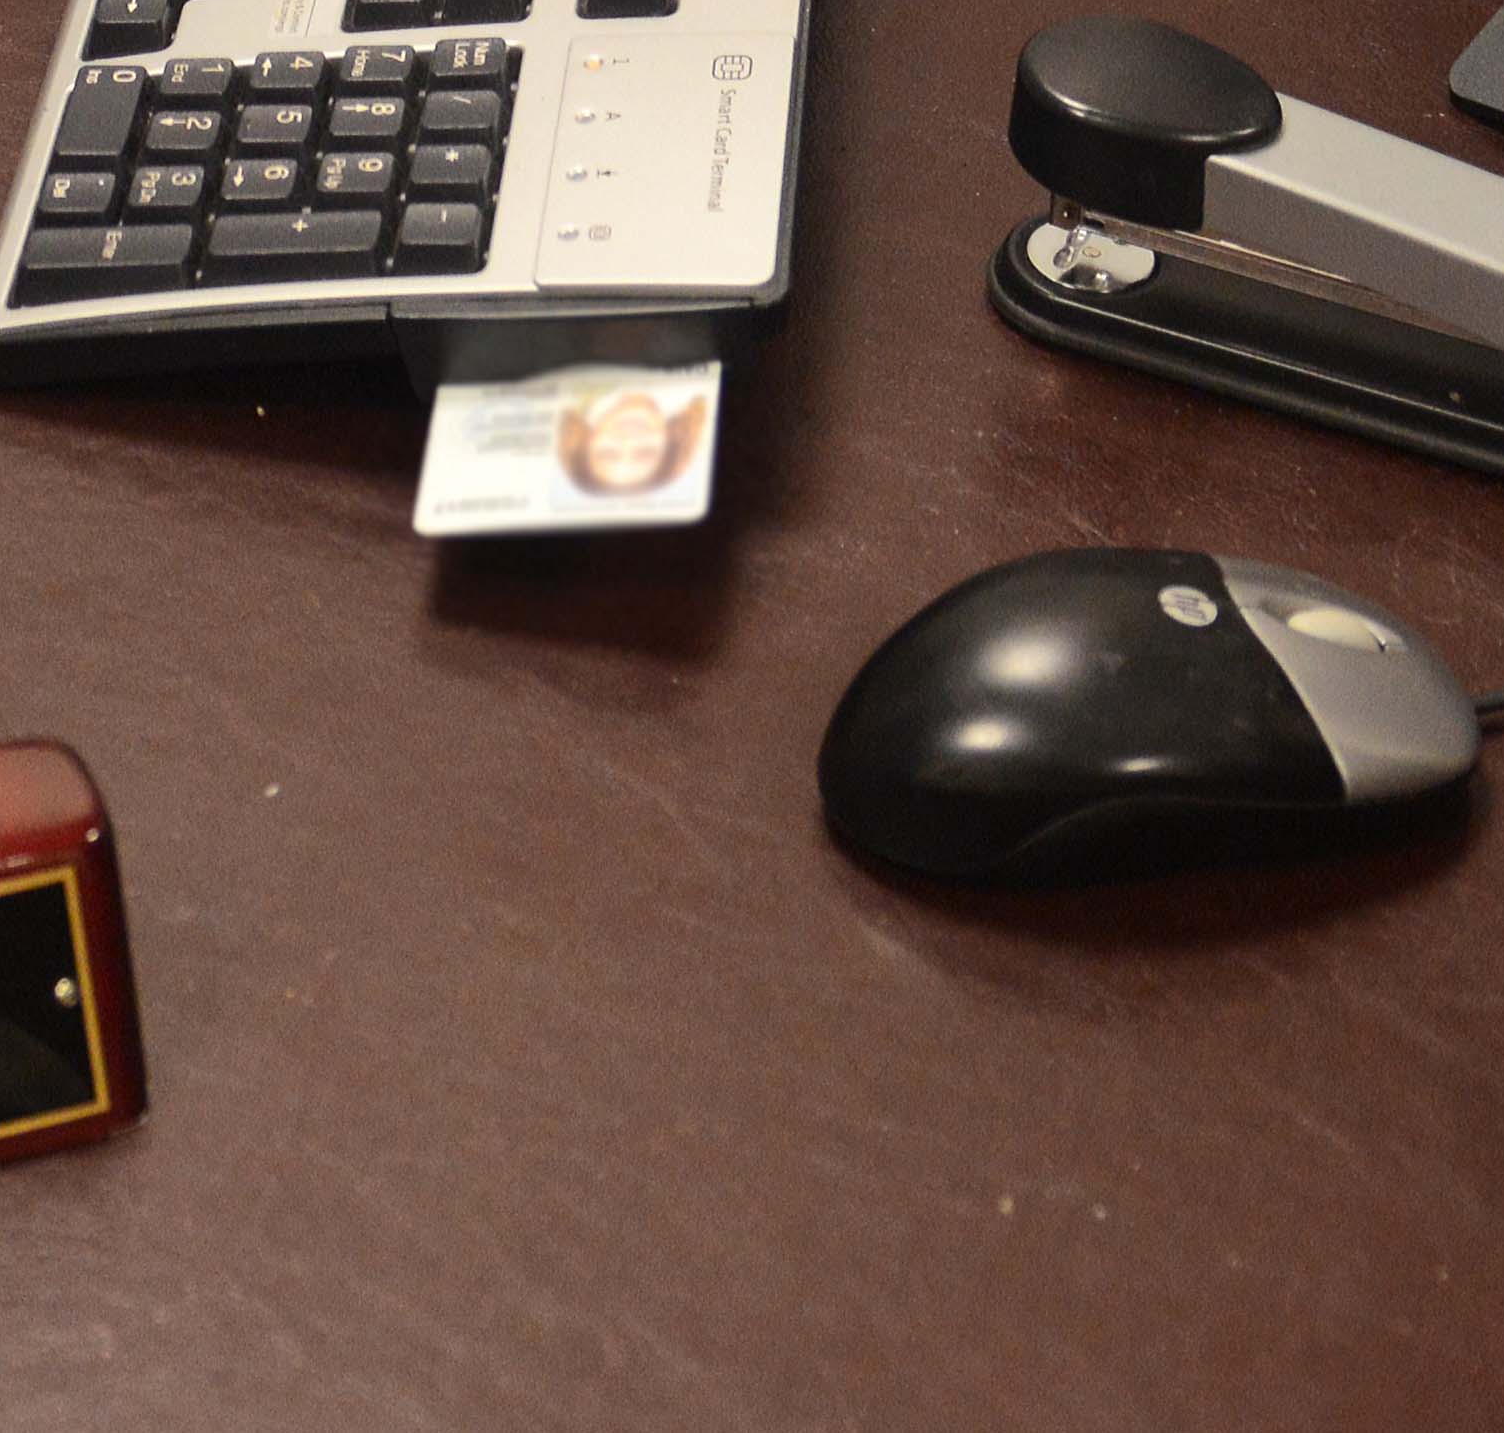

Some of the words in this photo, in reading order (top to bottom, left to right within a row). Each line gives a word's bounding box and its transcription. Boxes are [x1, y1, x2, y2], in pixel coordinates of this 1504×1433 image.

[381, 49, 407, 63] 7
[453, 41, 469, 68] Lock
[473, 41, 489, 66] Num
[201, 63, 225, 72] 1
[290, 55, 314, 70] 4
[353, 49, 370, 77] Home
[112, 69, 137, 83] 0
[171, 63, 190, 83] End
[371, 102, 396, 116] 8
[716, 87, 736, 124] Smart
[186, 116, 213, 130] 2
[276, 109, 303, 124] 5
[712, 126, 732, 156] Card
[264, 164, 290, 180] 6
[358, 157, 384, 172] 9
[171, 171, 197, 186] 3
[324, 157, 347, 189] PgUp
[53, 178, 71, 198] Del
[706, 157, 729, 213] Terminal
